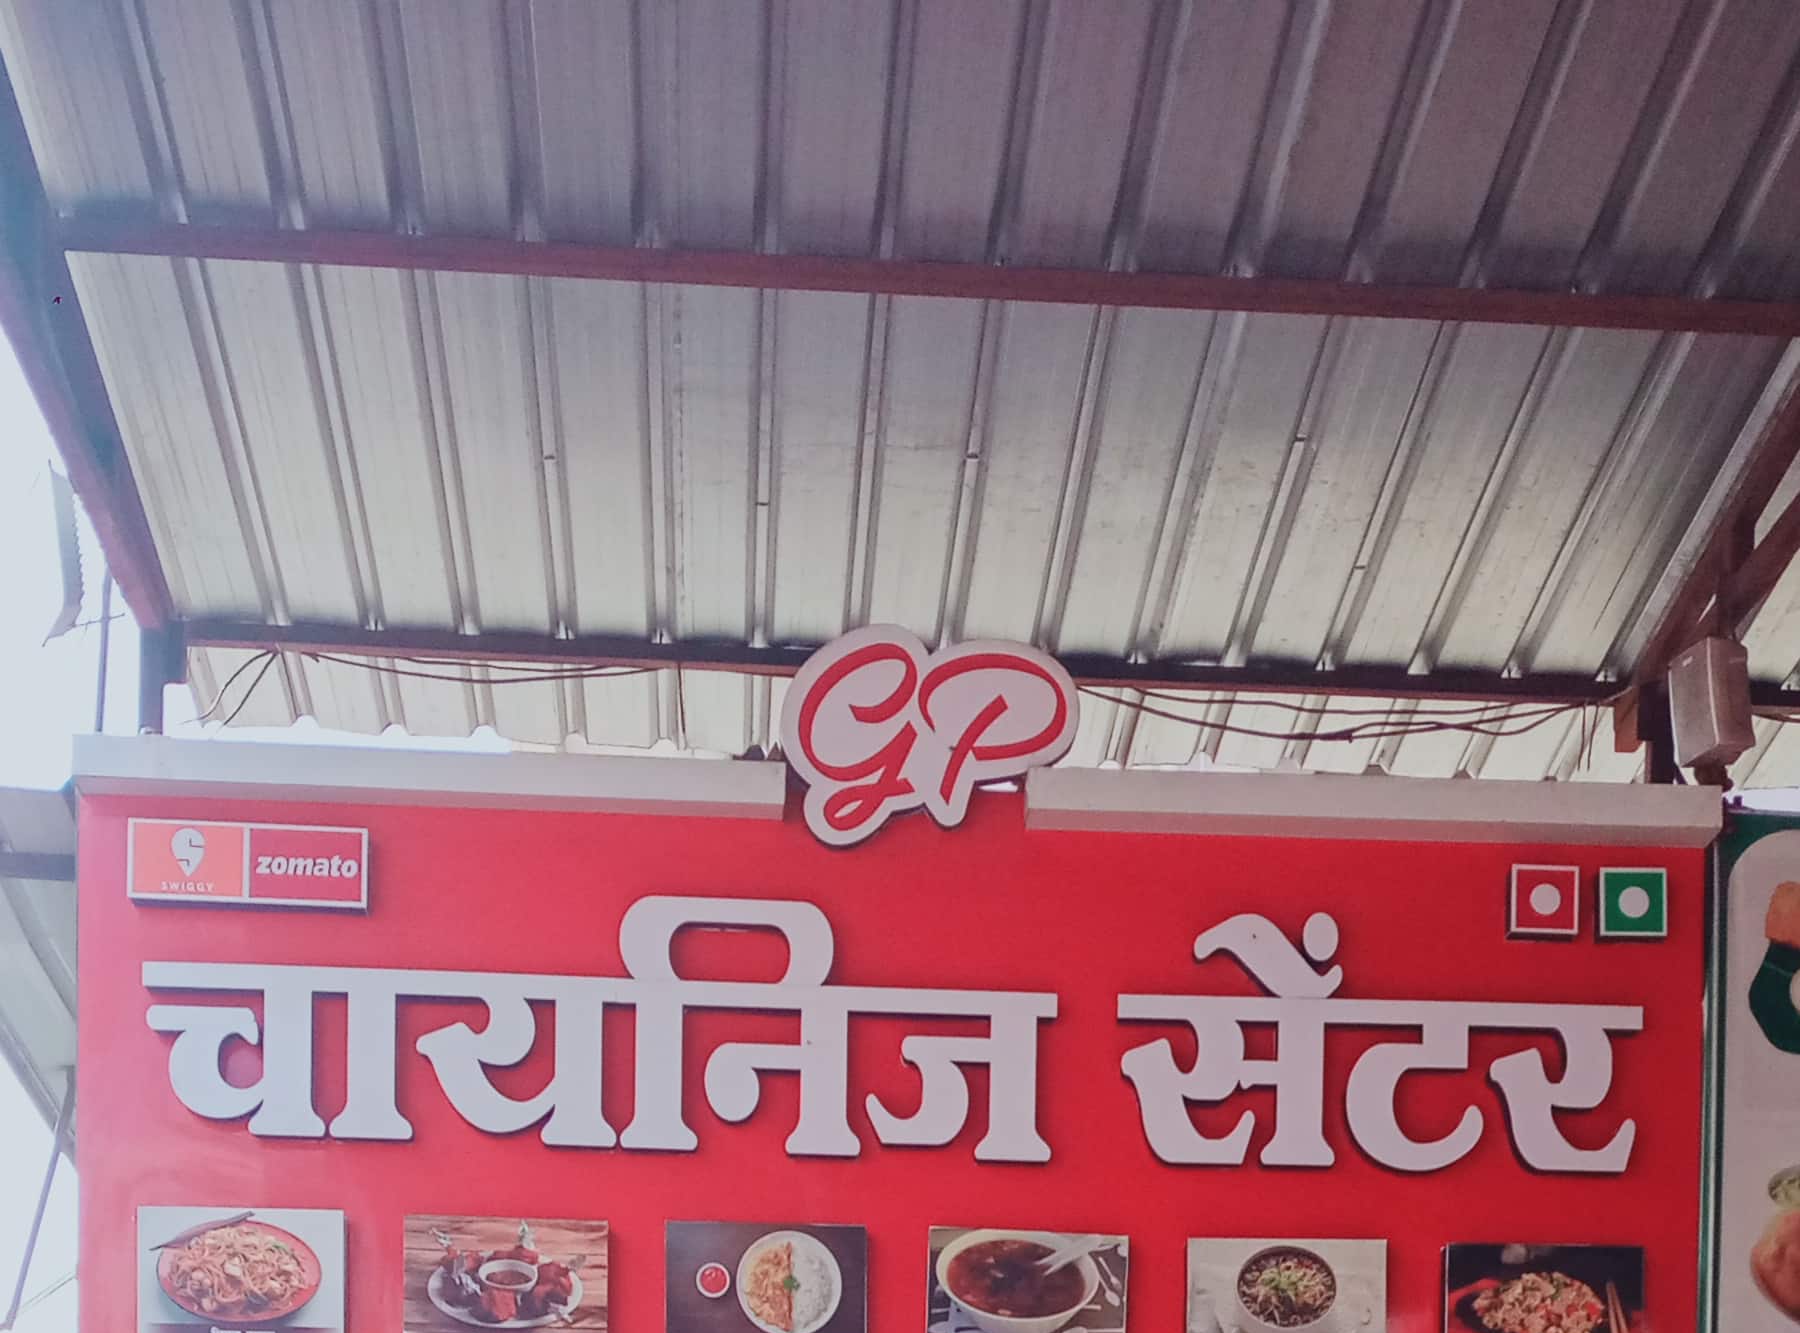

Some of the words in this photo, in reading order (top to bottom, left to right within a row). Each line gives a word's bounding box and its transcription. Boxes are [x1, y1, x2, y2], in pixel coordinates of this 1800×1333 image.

[798, 642, 1068, 840] GP
[160, 880, 215, 893] SWIGGY
[255, 853, 359, 879] zomato
[141, 895, 1057, 1162] चायनिज
[1117, 911, 1644, 1173] सेंटर
